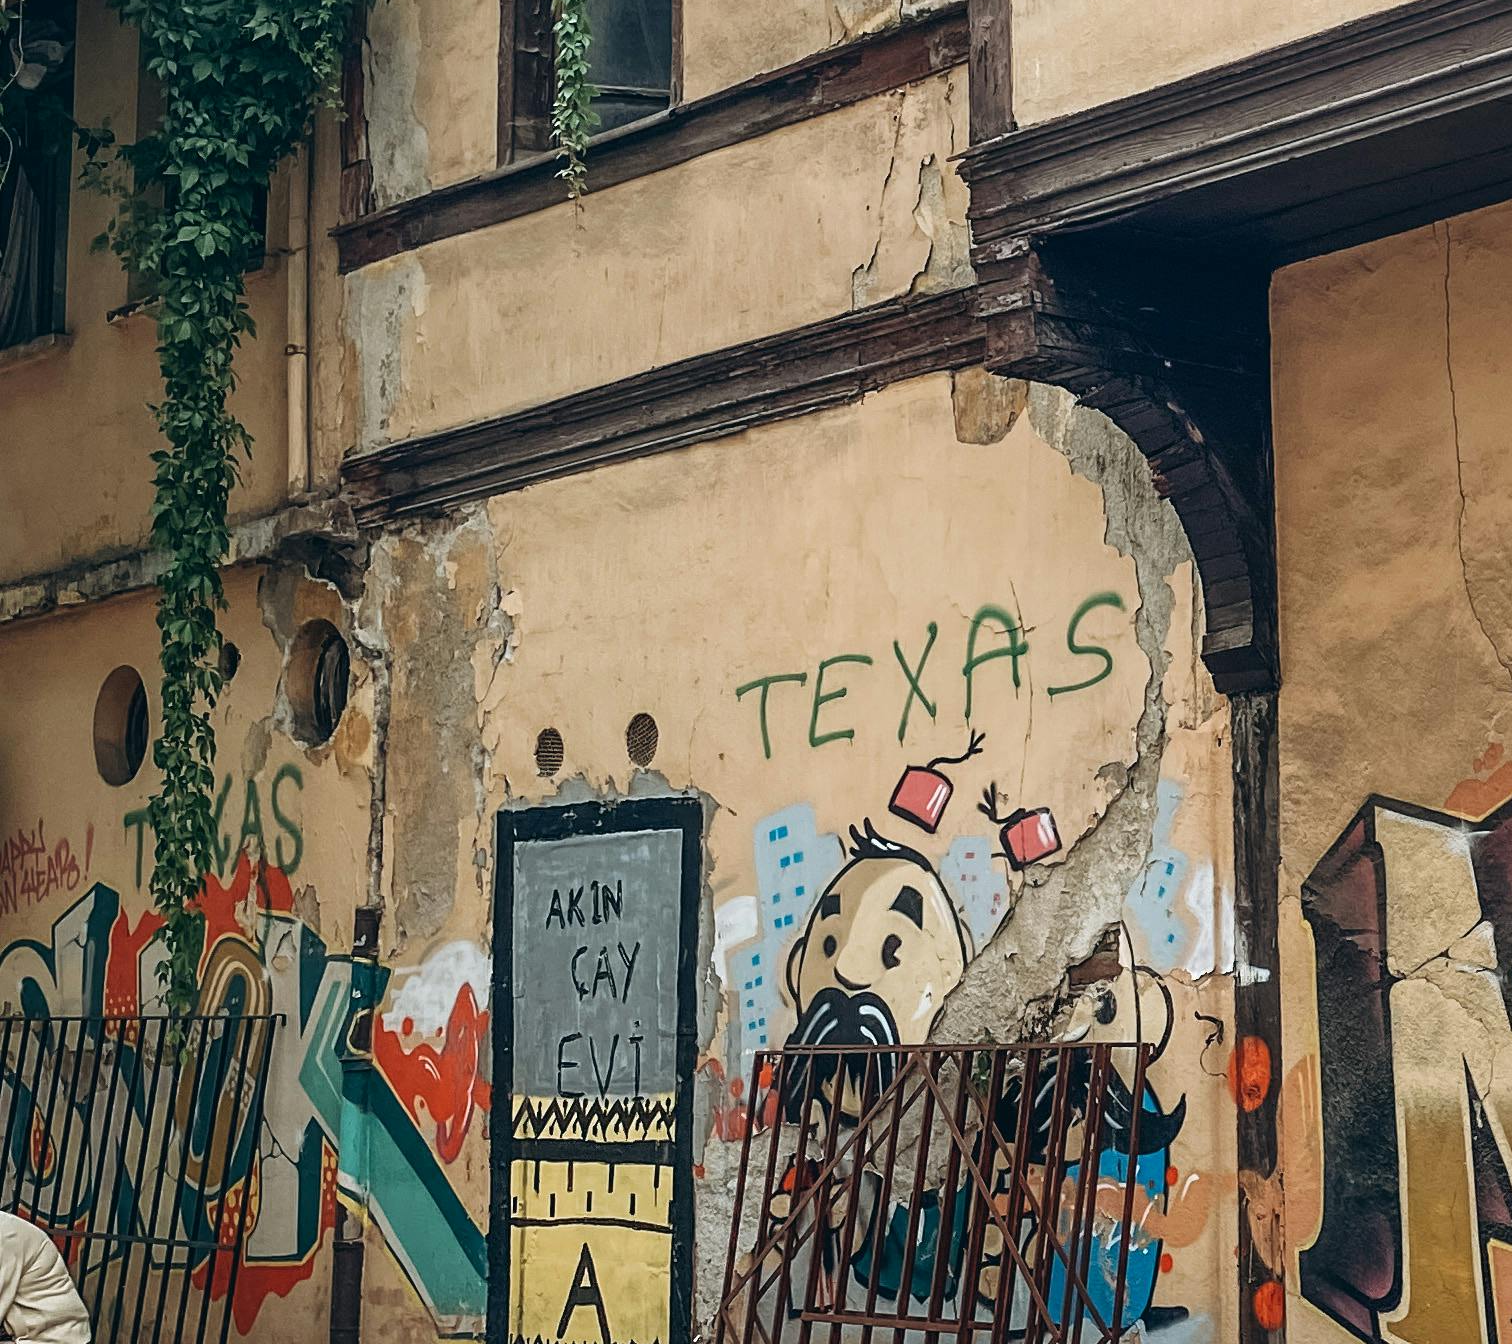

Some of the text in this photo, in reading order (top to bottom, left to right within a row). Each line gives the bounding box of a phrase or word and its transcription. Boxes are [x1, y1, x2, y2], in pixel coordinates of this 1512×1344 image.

[736, 593, 1125, 759] TEXAS
[546, 879, 622, 930] AKIN
[571, 941, 641, 1005] ÇAY
[558, 1021, 644, 1102] EVİ
